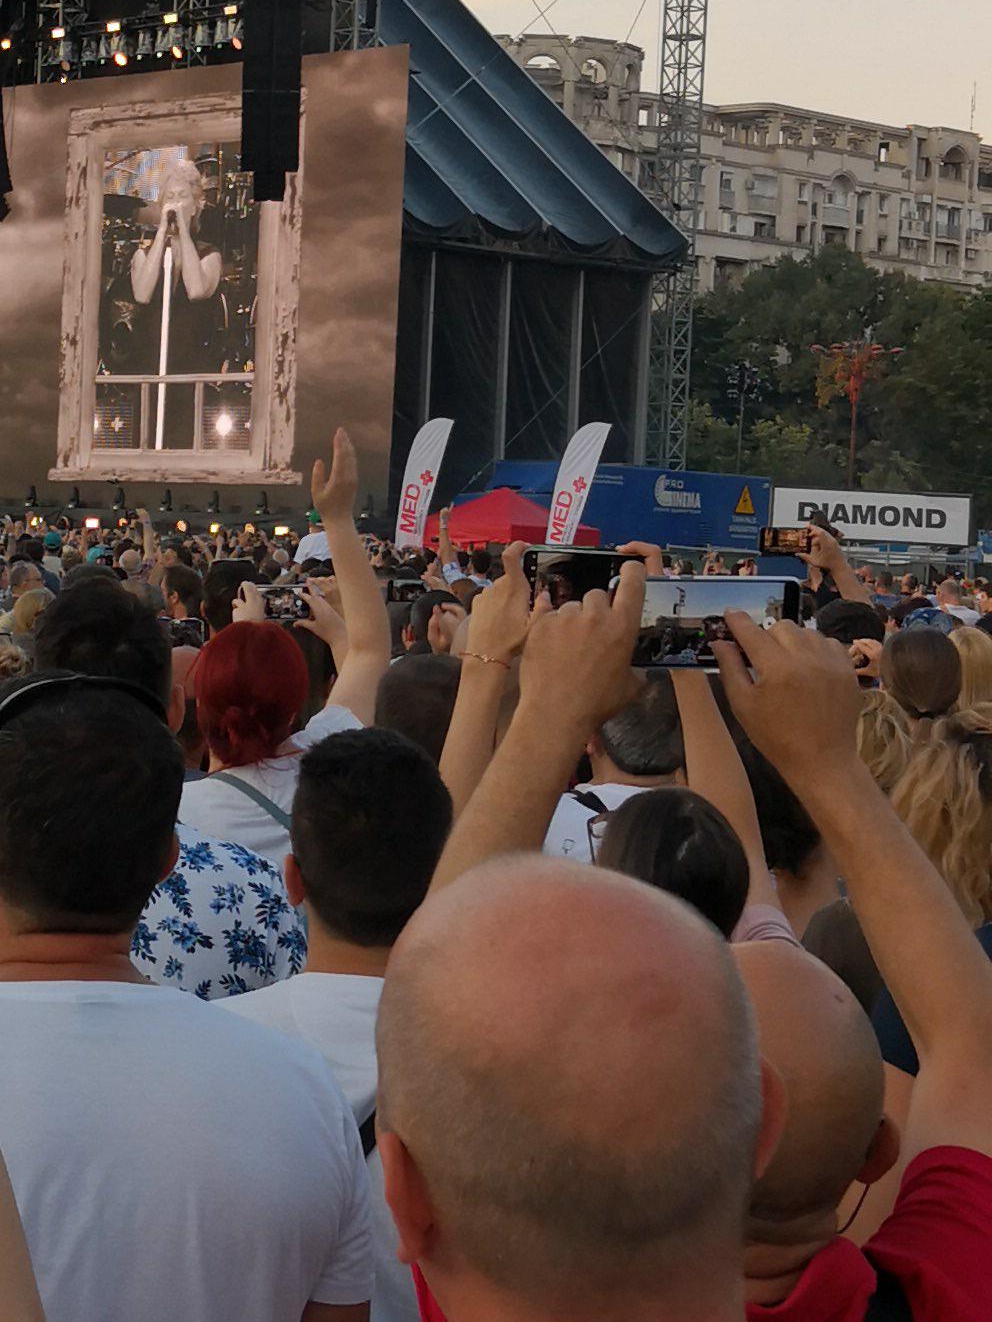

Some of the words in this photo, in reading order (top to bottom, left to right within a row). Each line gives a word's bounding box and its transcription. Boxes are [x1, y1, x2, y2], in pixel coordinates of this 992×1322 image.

[399, 483, 421, 534] MED
[550, 490, 572, 543] MED
[797, 501, 947, 529] DIAMOND
